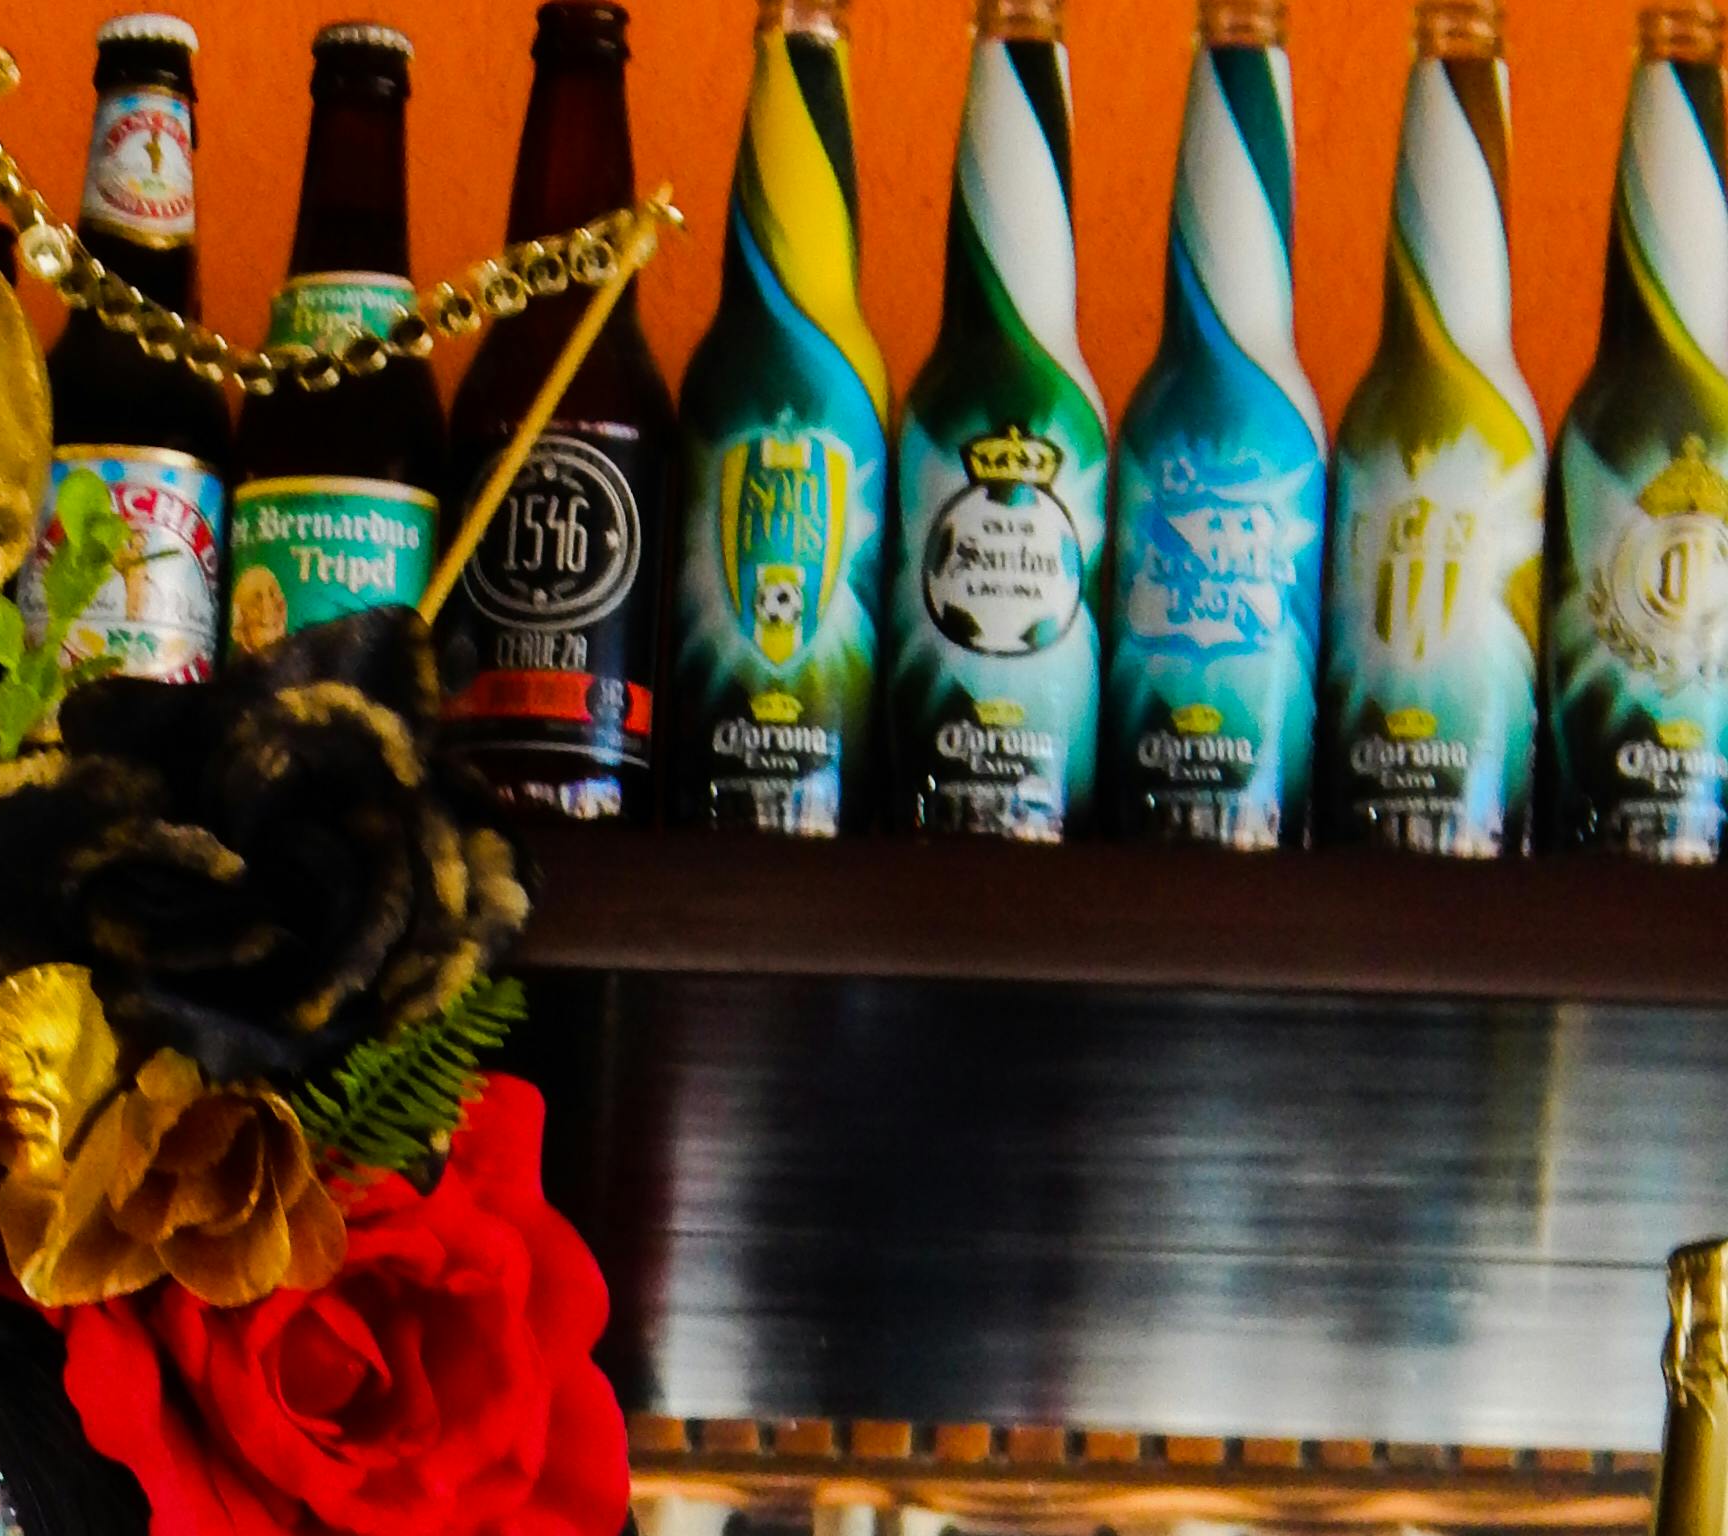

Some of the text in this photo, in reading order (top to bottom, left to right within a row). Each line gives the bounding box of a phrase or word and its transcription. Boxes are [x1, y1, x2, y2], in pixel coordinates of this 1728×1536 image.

[257, 505, 420, 550] Bernardus
[502, 494, 590, 572] 1546
[289, 544, 398, 595] Tripel
[954, 537, 1058, 576] Santos
[497, 631, 588, 669] CERVEZA
[712, 716, 828, 758] Corona
[936, 720, 1054, 762] Corona
[1138, 730, 1253, 770] Corona
[1350, 736, 1469, 775] Corona
